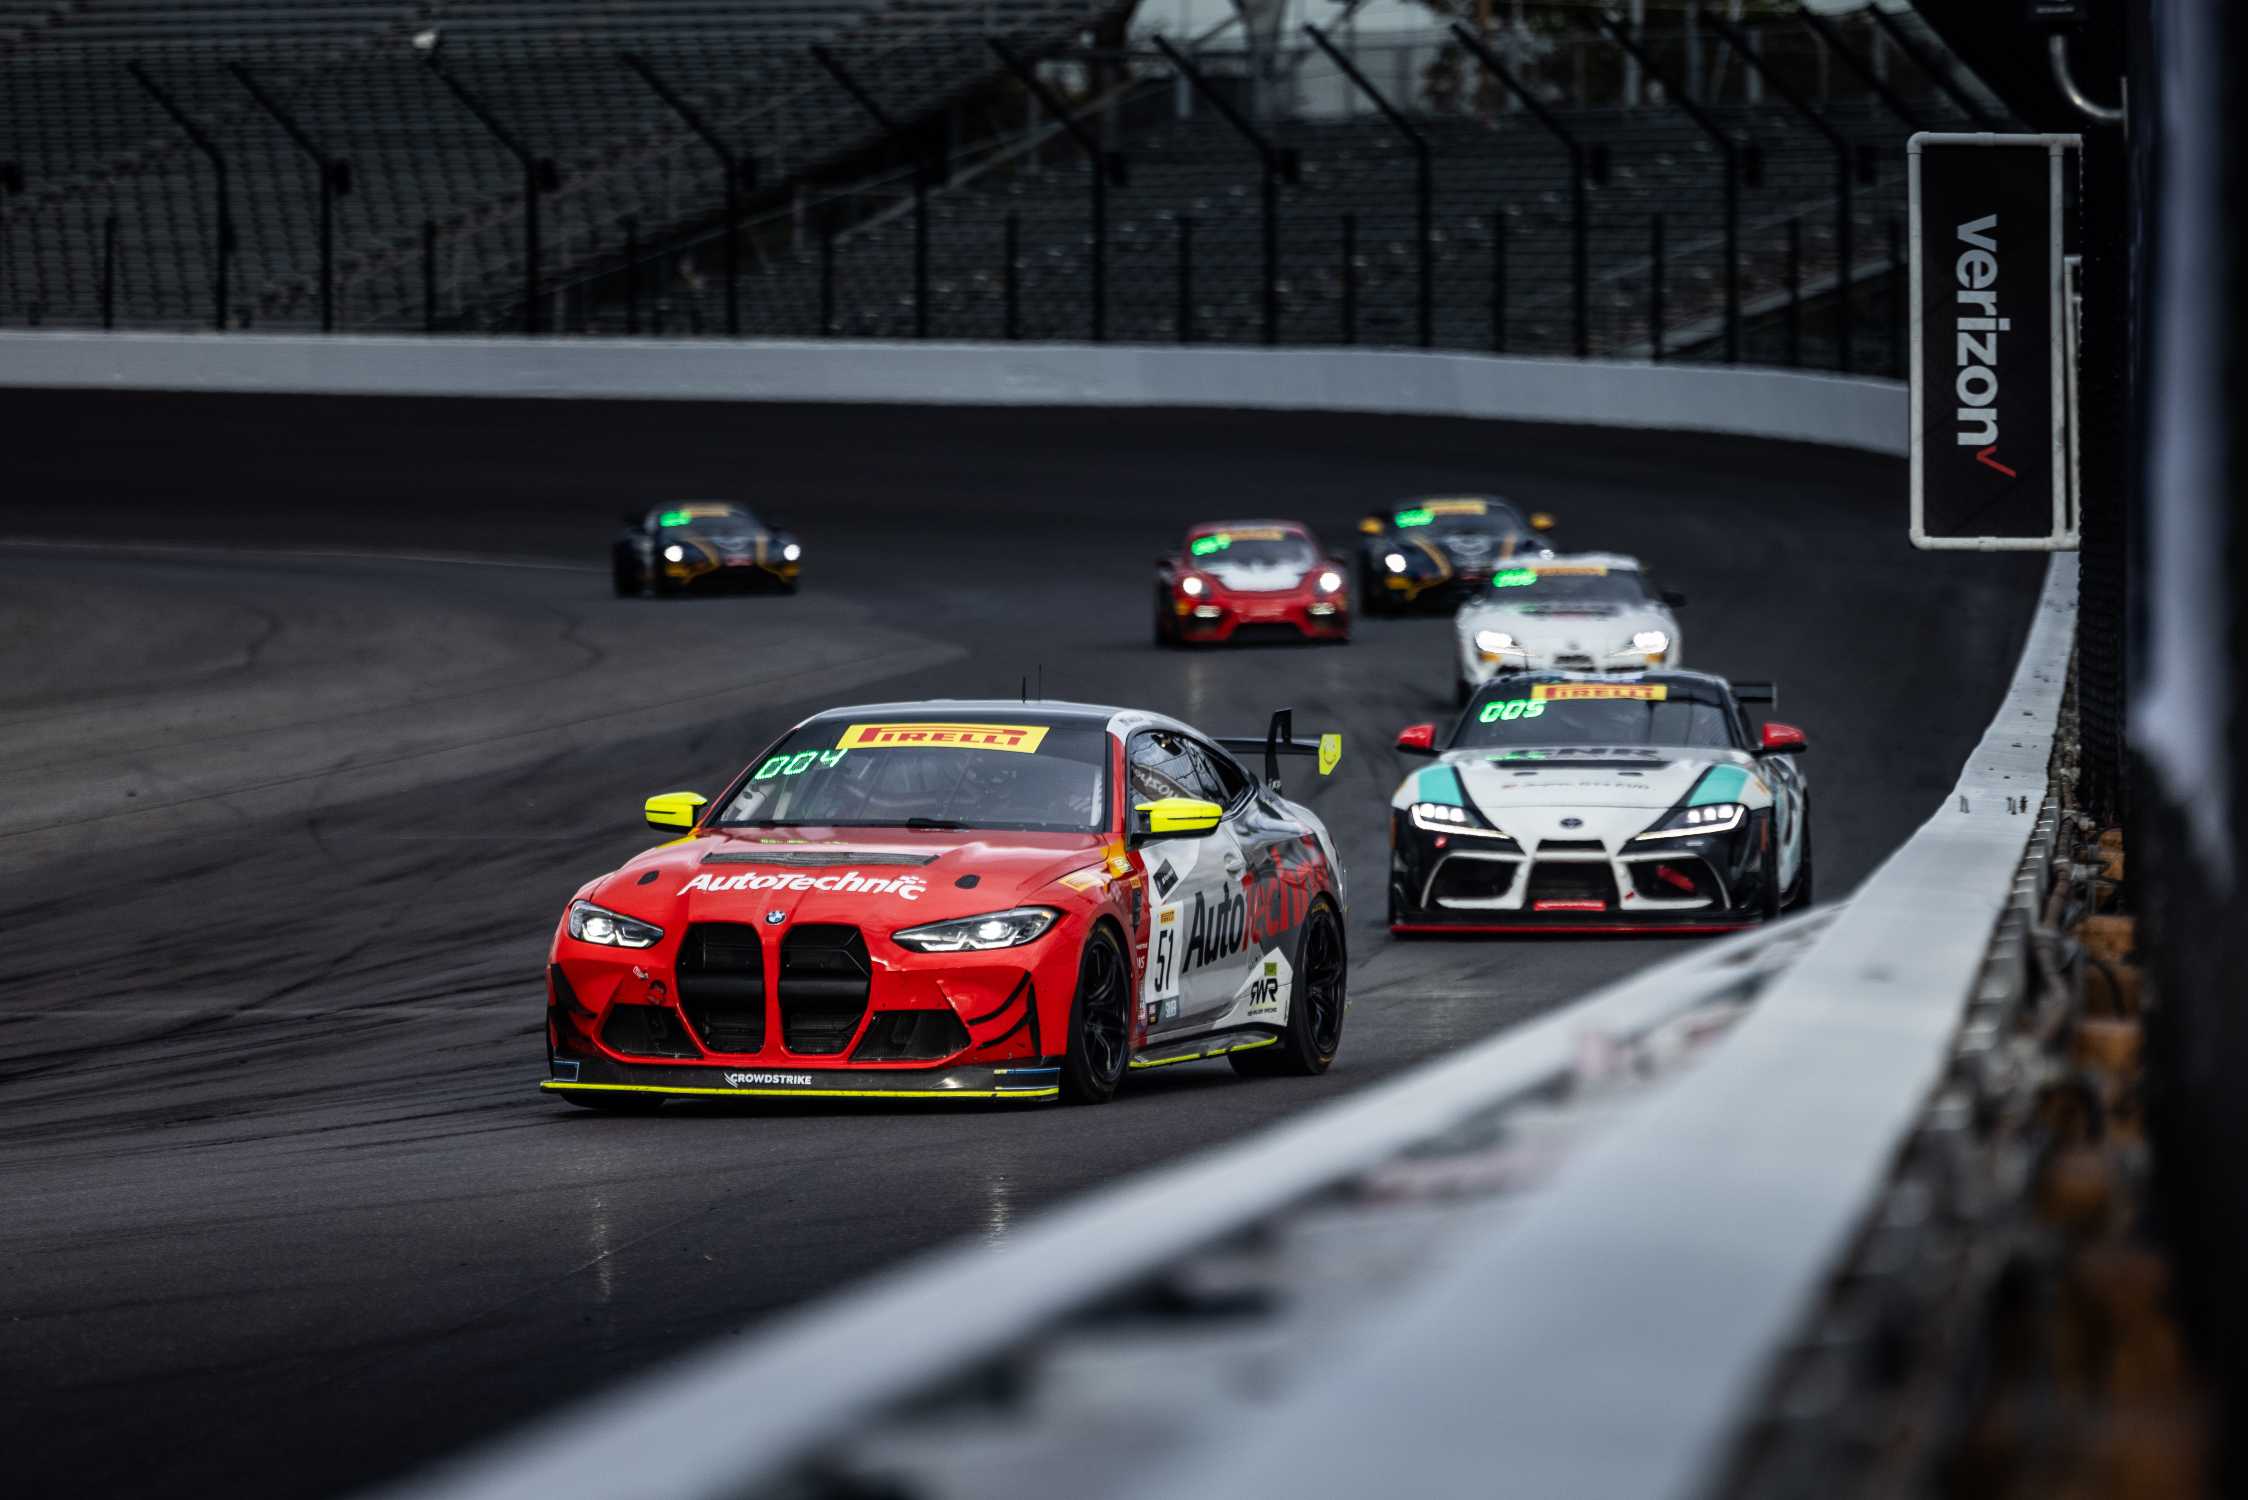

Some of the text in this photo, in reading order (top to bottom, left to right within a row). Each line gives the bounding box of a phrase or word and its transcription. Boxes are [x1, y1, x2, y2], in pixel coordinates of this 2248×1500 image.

[1955, 213, 2011, 446] verizon
[1544, 684, 1654, 699] PIRELLI
[1478, 700, 1547, 723] 005
[857, 726, 1028, 746] PIRELLI
[754, 748, 849, 780] 004
[676, 871, 928, 901] AutoTechnic
[1154, 928, 1174, 993] 51
[729, 1072, 813, 1086] CROWDSTRIKE
